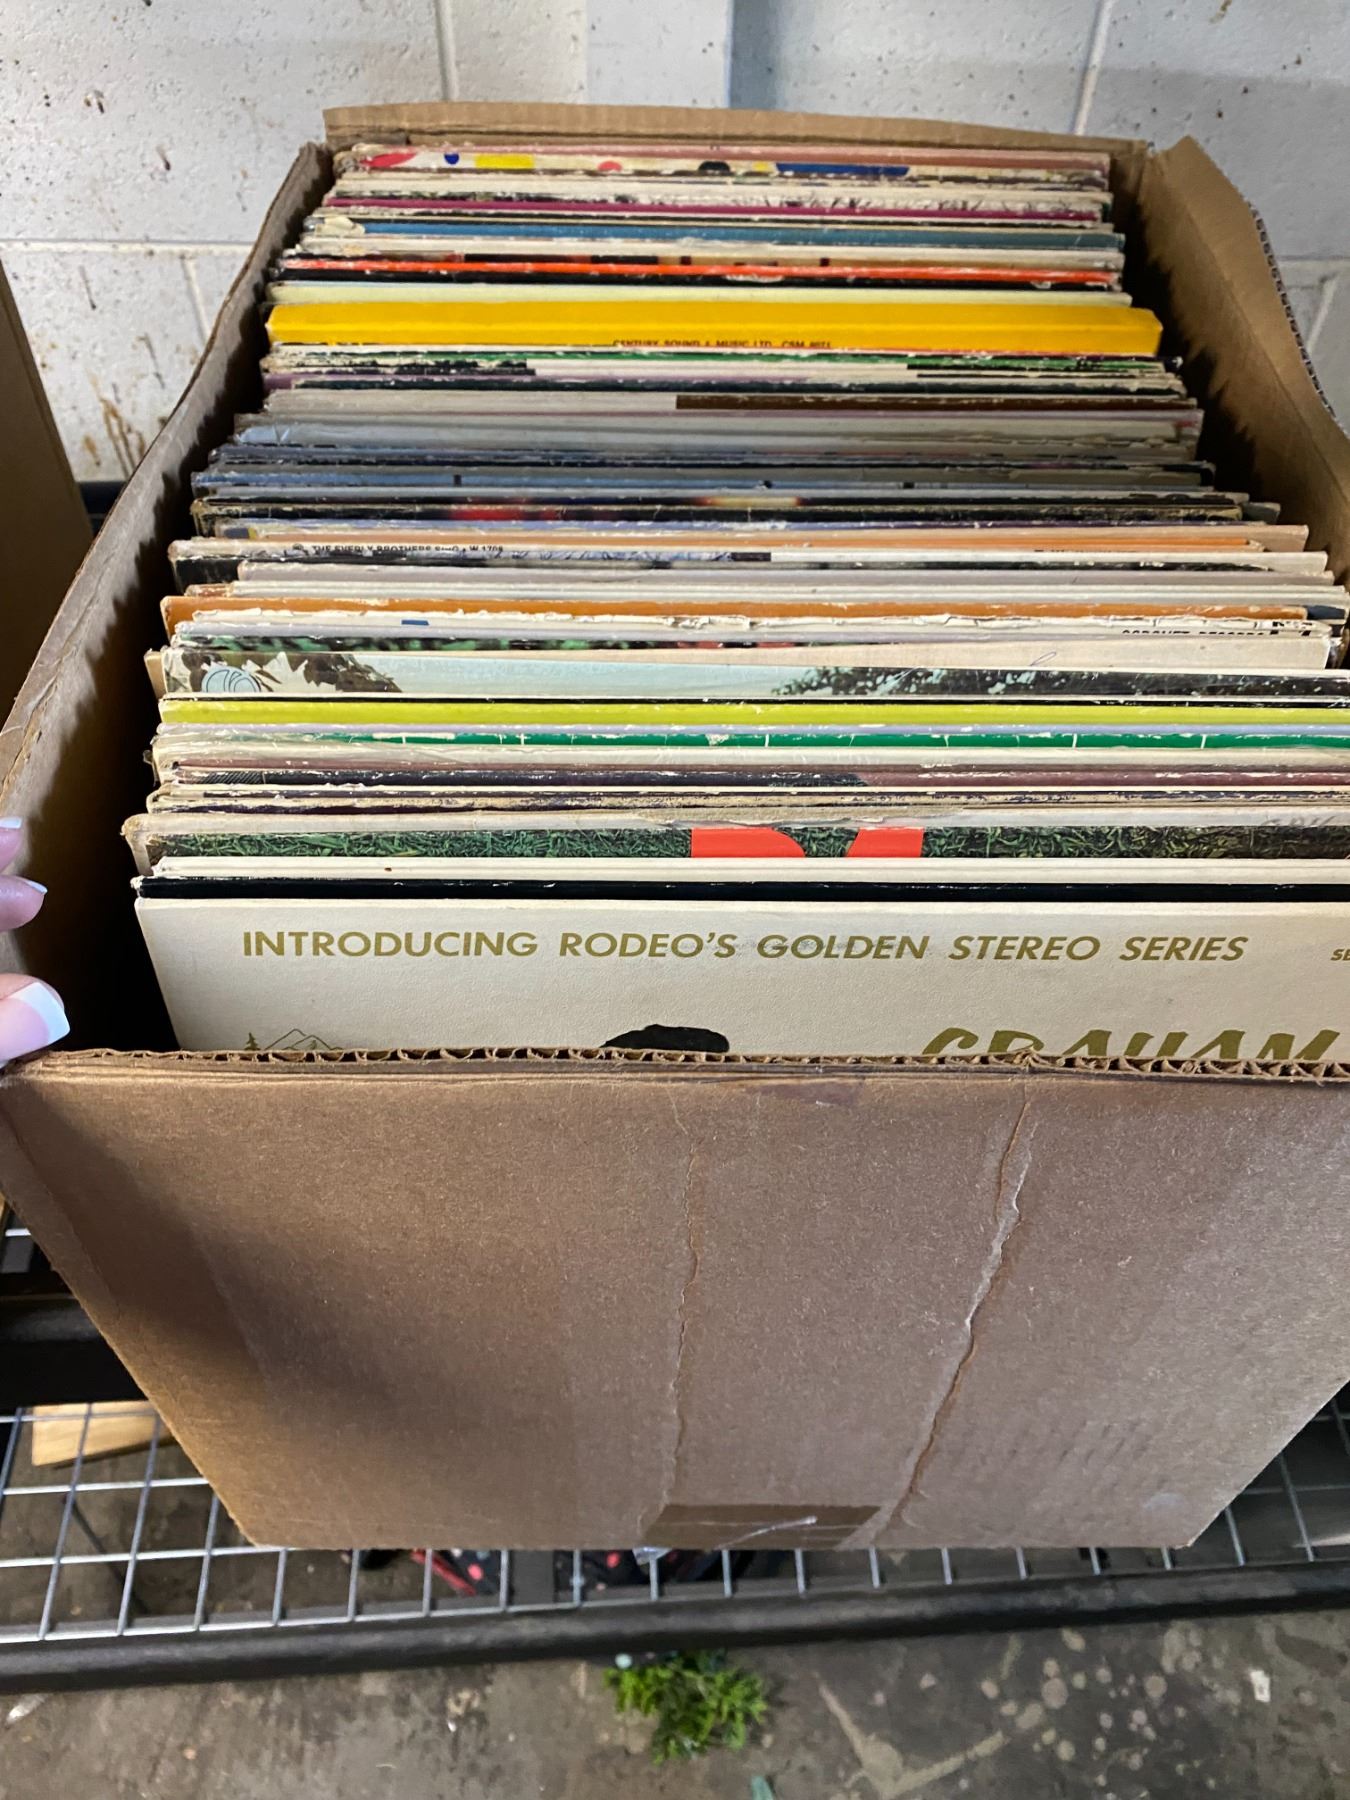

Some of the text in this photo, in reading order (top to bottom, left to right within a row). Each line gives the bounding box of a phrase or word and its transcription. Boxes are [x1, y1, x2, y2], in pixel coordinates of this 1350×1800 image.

[243, 931, 1249, 961] INTRODUCING RODEO'S GOLDEN STEREO SERIES
